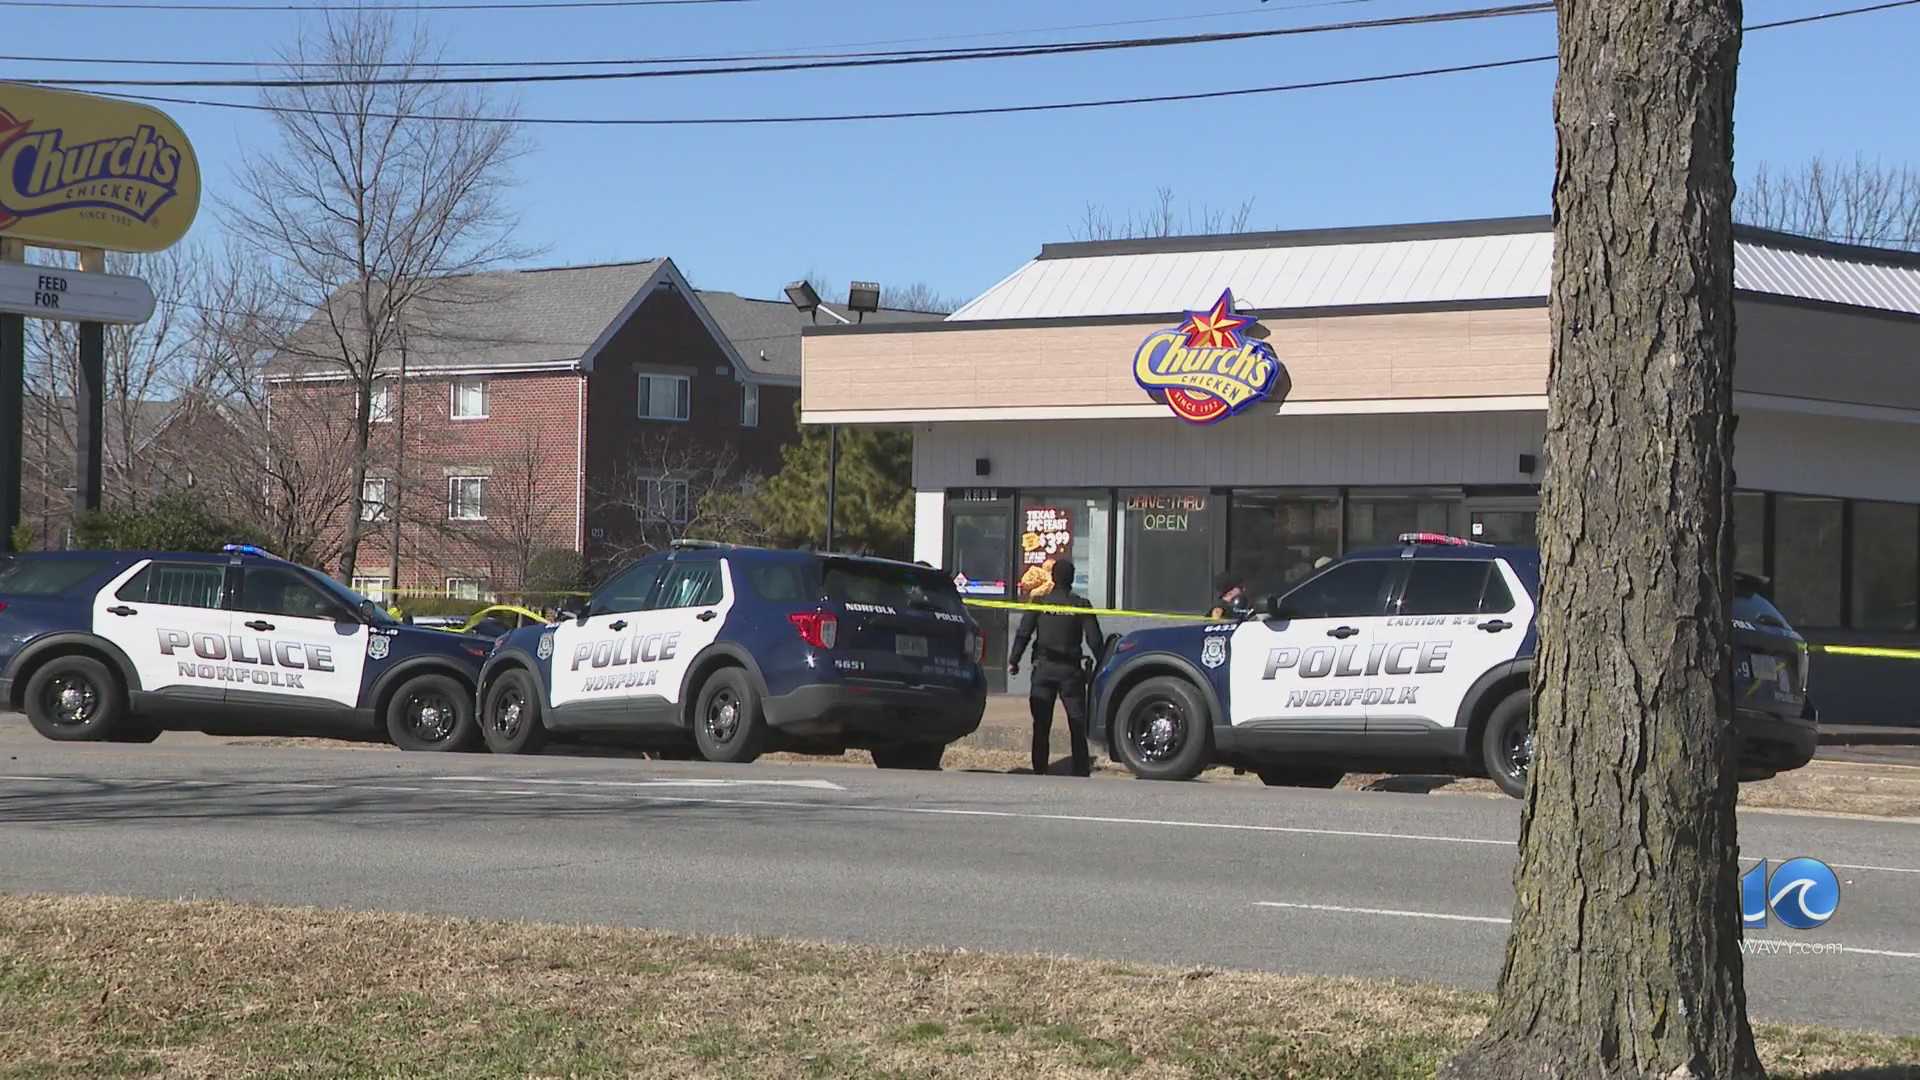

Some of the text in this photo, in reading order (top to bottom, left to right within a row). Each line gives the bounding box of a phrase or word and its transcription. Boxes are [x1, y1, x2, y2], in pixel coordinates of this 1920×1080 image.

[1, 124, 181, 200] Church's
[66, 183, 147, 208] CHICKEN
[79, 210, 106, 221] SINCE
[38, 275, 67, 293] FEED
[34, 291, 59, 308] FOR
[1136, 333, 1271, 388] Church's
[1181, 375, 1241, 401] CHICKEN
[1174, 391, 1219, 413] SINCE 1952
[1026, 509, 1056, 520] TEXAS
[1044, 519, 1068, 531] FEAST
[1144, 514, 1188, 530] OPEN
[845, 602, 965, 624] NORFOLK POLICE
[1386, 616, 1447, 627] CAUTION
[156, 628, 335, 673] POLICE
[571, 631, 681, 671] POLICE
[1261, 640, 1453, 681] POLICE
[178, 661, 305, 689] NORFOLK
[581, 669, 660, 693] NORFOLK
[1284, 686, 1421, 709] NORFOLK
